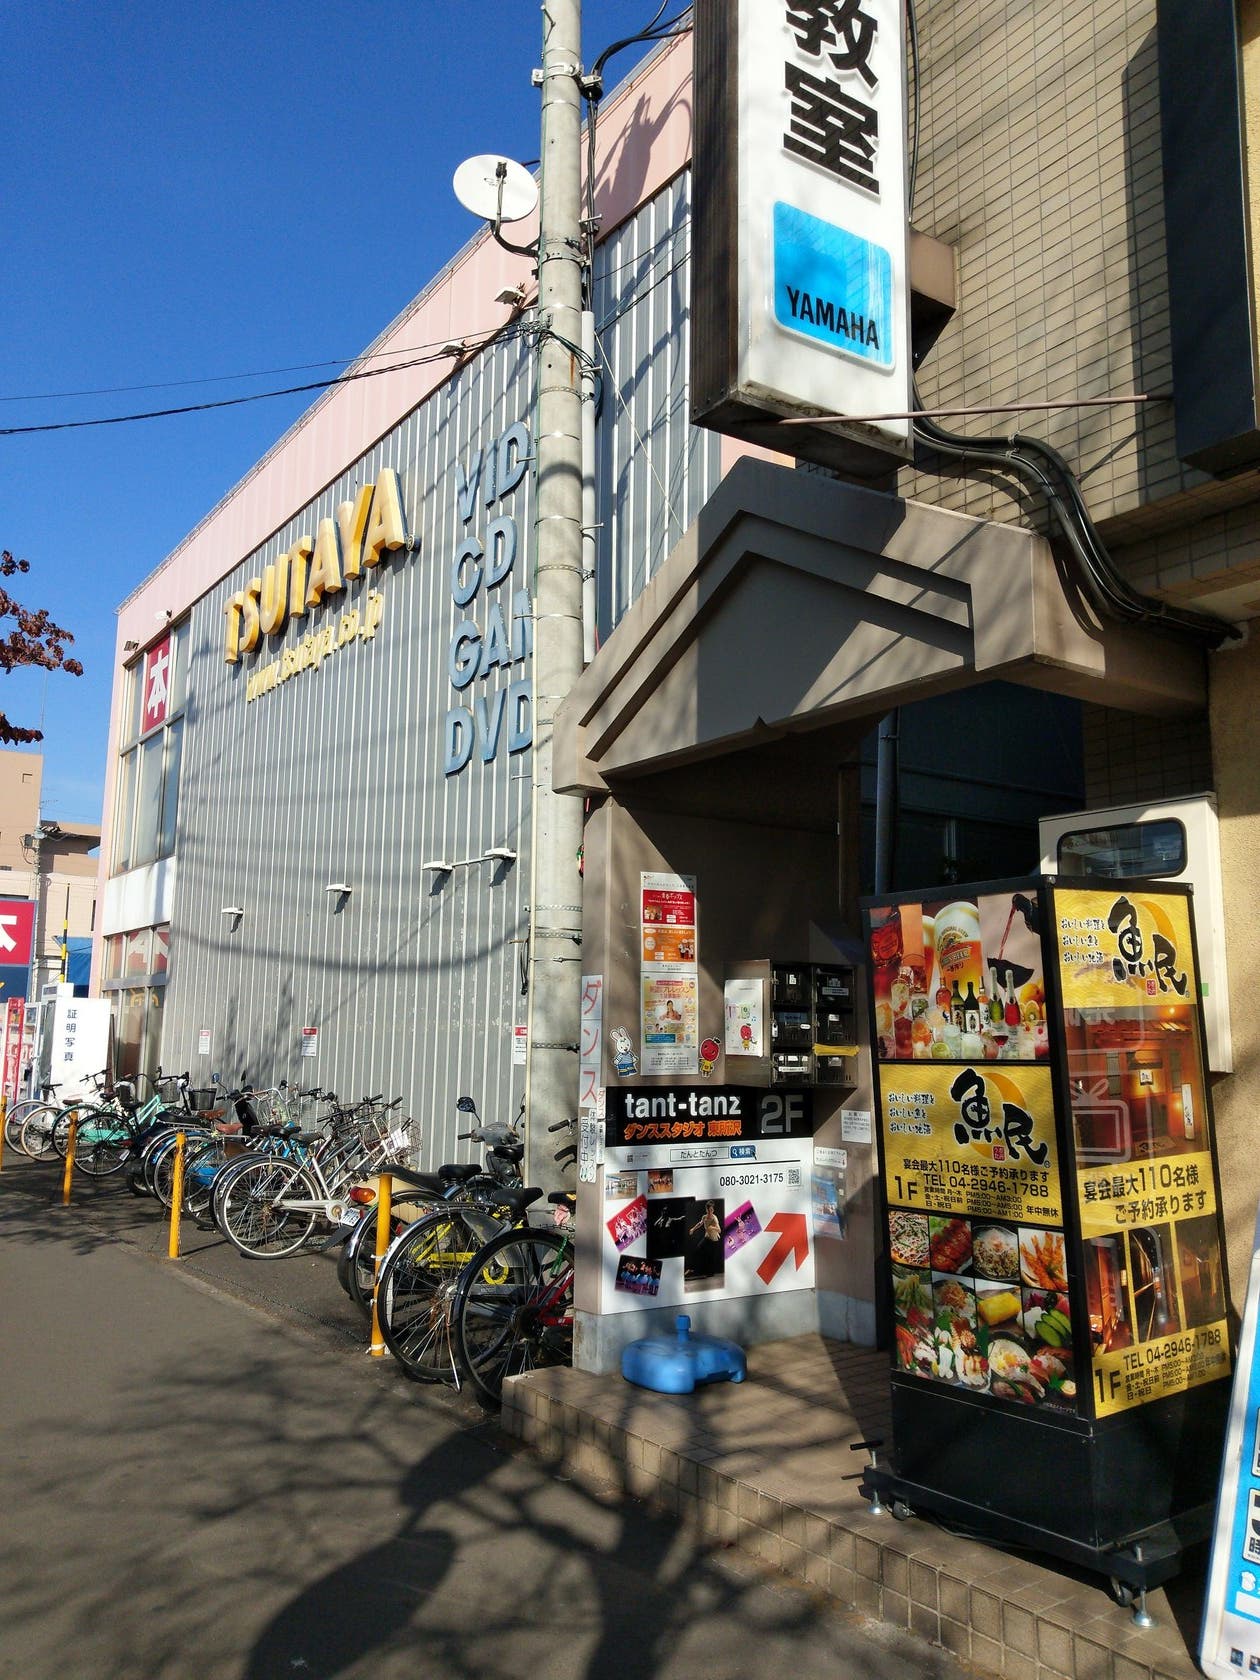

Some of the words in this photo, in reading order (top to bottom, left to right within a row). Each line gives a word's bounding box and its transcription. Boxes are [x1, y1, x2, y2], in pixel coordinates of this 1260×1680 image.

[786, 286, 880, 350] YAMAHA
[224, 467, 406, 664] TSUTAYA
[453, 515, 517, 608] CD
[147, 649, 169, 718] 本
[444, 679, 532, 775] DVD
[1107, 896, 1188, 996] 魚民
[63, 1009, 78, 1062] 証明写真
[582, 980, 602, 1103] ダンス
[624, 1092, 742, 1119] tant-tanz
[761, 1093, 804, 1134] 2F
[950, 1067, 1048, 1165] 魚民
[624, 1121, 705, 1141] ダンススタジオ
[719, 1172, 784, 1187] 080-3021-3175
[894, 1175, 918, 1201] 1F
[923, 1173, 946, 1187] TEL
[950, 1175, 1050, 1198] 04-2946-1788
[1083, 1163, 1200, 1203] 宴会最大110名様
[1114, 1189, 1208, 1225] ご予約承ります
[1123, 1352, 1144, 1371] TEL
[1146, 1328, 1221, 1364] 04-2946-1788
[1094, 1367, 1121, 1404] 1F
